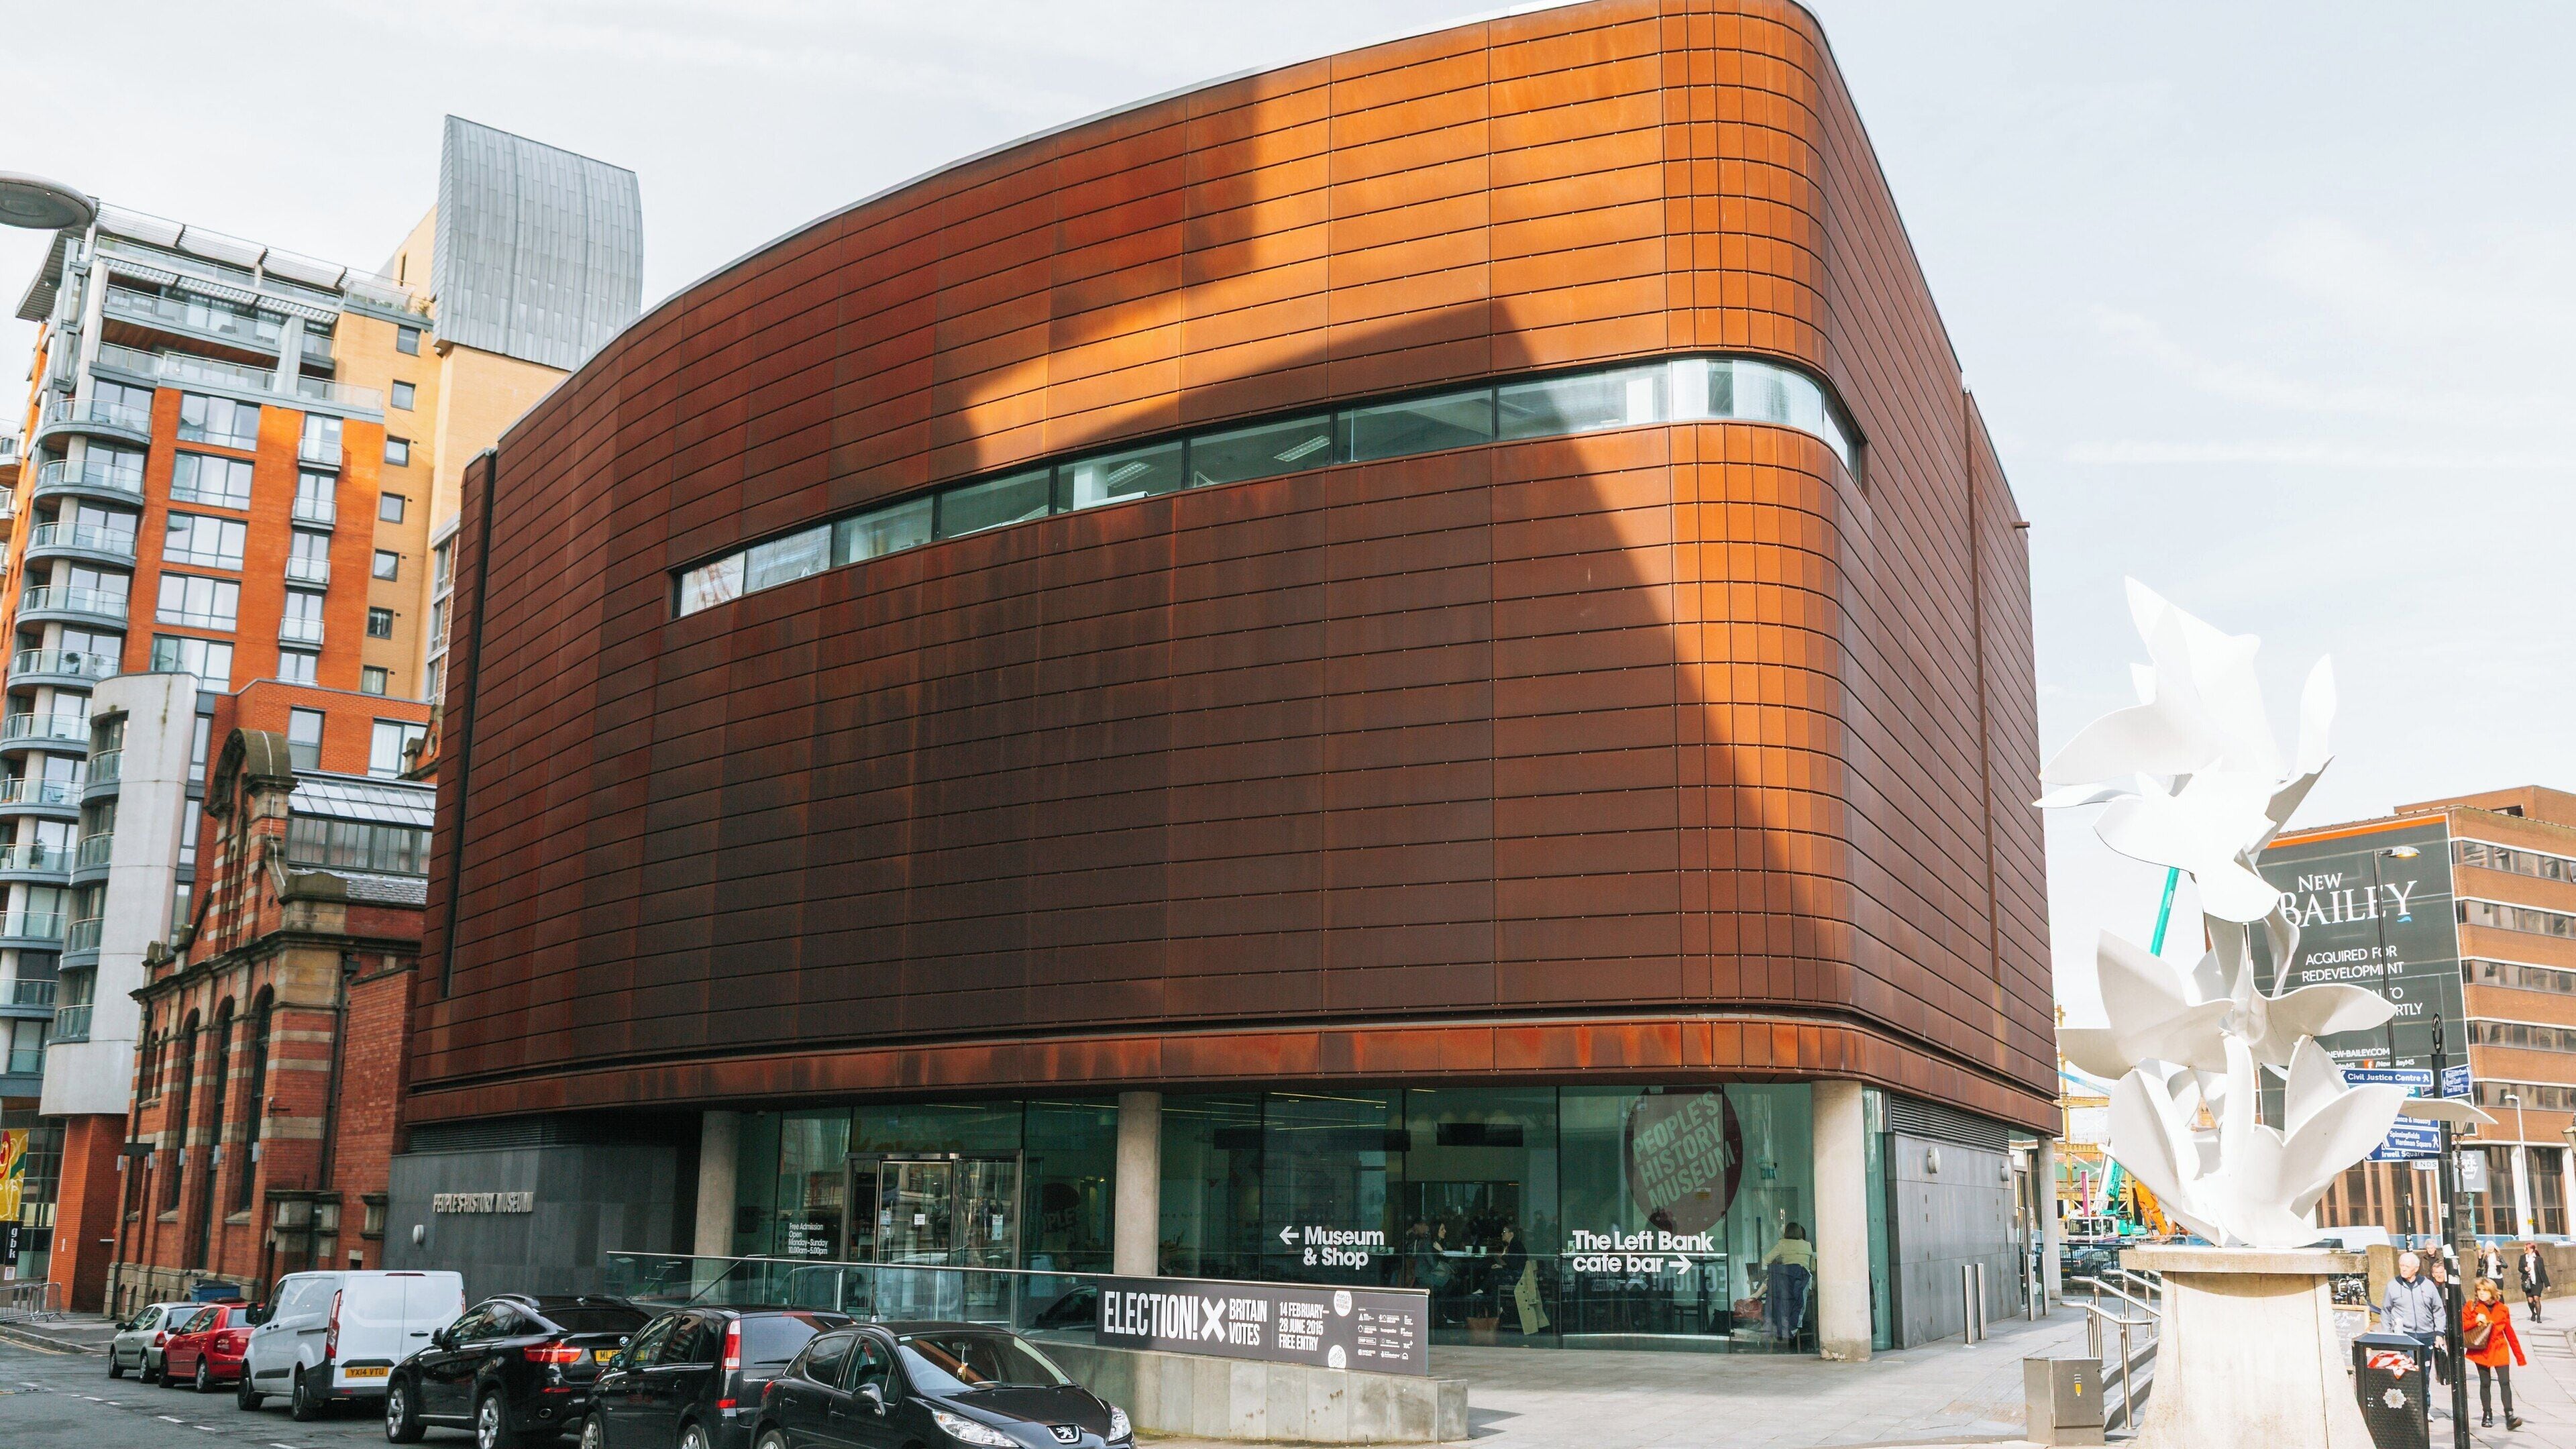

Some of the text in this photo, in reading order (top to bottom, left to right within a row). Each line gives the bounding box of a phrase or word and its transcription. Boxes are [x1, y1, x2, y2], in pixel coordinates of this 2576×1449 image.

[2298, 873, 2343, 893] NEW
[2281, 880, 2418, 928] BAILEY
[2306, 948, 2367, 965] ACQUIRED
[2302, 961, 2404, 982] REDEVELOPMNT
[1633, 1091, 1719, 1163] PEOPLE'S
[2390, 1131, 2420, 1139] Spinningfields
[1639, 1117, 1721, 1188] HISTORY
[2416, 1140, 2432, 1148] Square
[2402, 1150, 2424, 1159] Square
[1648, 1140, 1735, 1208] MUSEUM
[788, 1230, 802, 1240] Open
[800, 1222, 824, 1230] Admission
[1305, 1226, 1384, 1246] Museum
[9, 1228, 18, 1258] gbk
[1572, 1230, 1715, 1251] The Left Bank
[1303, 1247, 1369, 1270] & Shop
[1572, 1254, 1664, 1273] cafe bar
[1104, 1291, 1199, 1340] ELECTION!
[1228, 1298, 1267, 1322] BRITAIN
[1279, 1301, 1288, 1316] 14
[1228, 1322, 1260, 1346] VOTES
[1279, 1318, 1324, 1335] 28 JUNE 2015
[1279, 1334, 1319, 1351] FREE ENTRY
[350, 1367, 384, 1376] YX14 VTU
